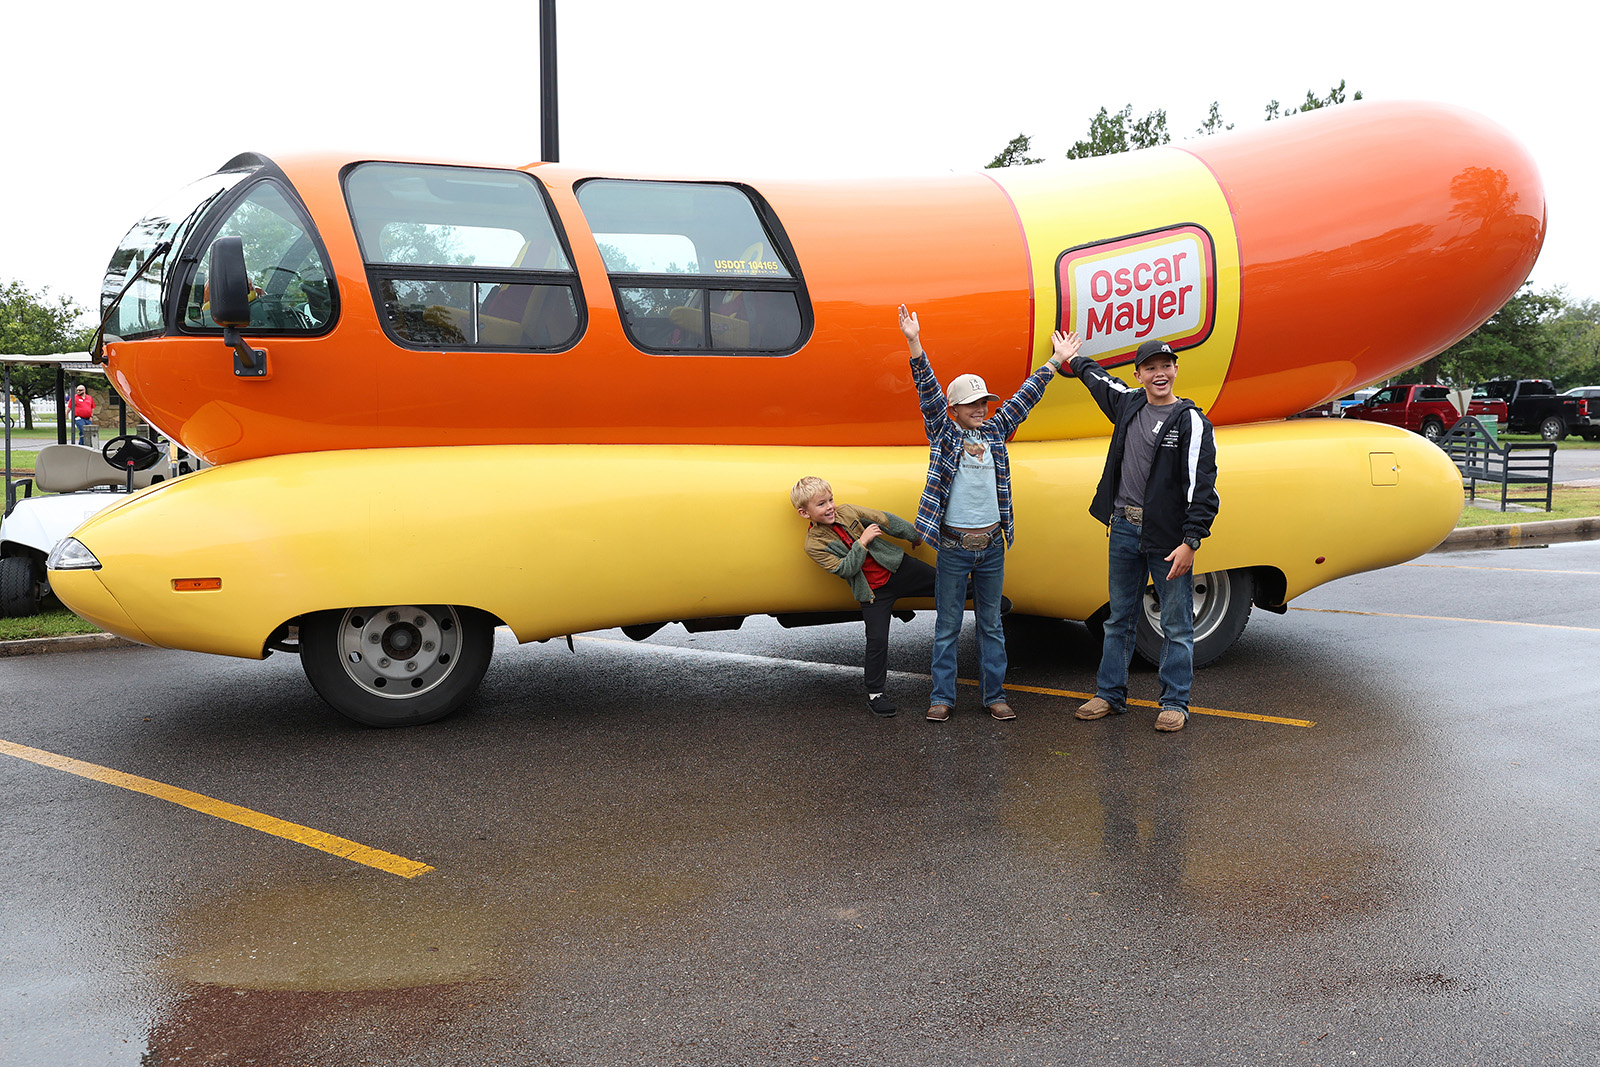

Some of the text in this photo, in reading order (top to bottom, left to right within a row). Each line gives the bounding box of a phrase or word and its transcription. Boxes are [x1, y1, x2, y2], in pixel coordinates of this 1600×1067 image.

[714, 260, 779, 270] USDOT 104165
[1090, 252, 1187, 303] Oscar
[1086, 285, 1193, 341] Mayer
